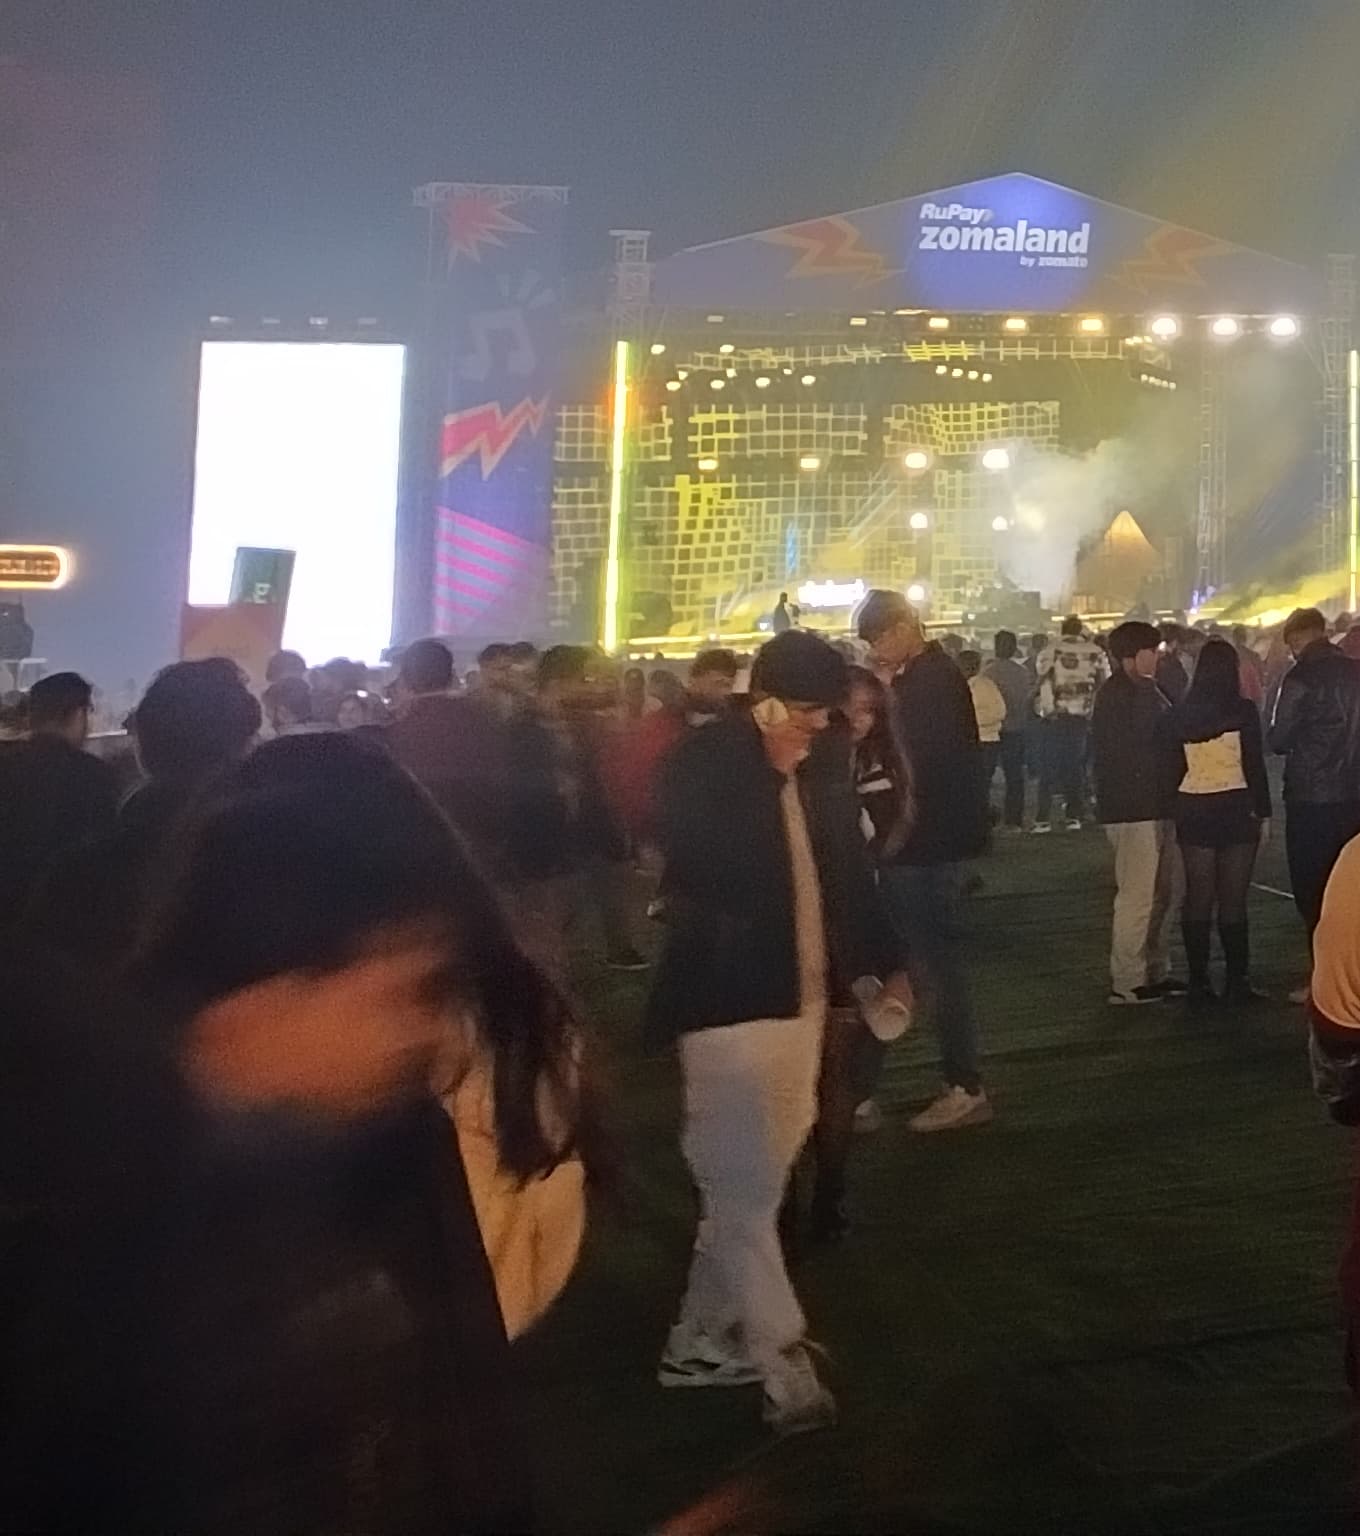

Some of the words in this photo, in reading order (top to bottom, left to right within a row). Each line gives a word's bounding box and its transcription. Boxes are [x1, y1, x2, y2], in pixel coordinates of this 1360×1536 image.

[919, 202, 986, 225] RuPay
[918, 219, 1090, 254] zomaland
[1019, 256, 1036, 268] by
